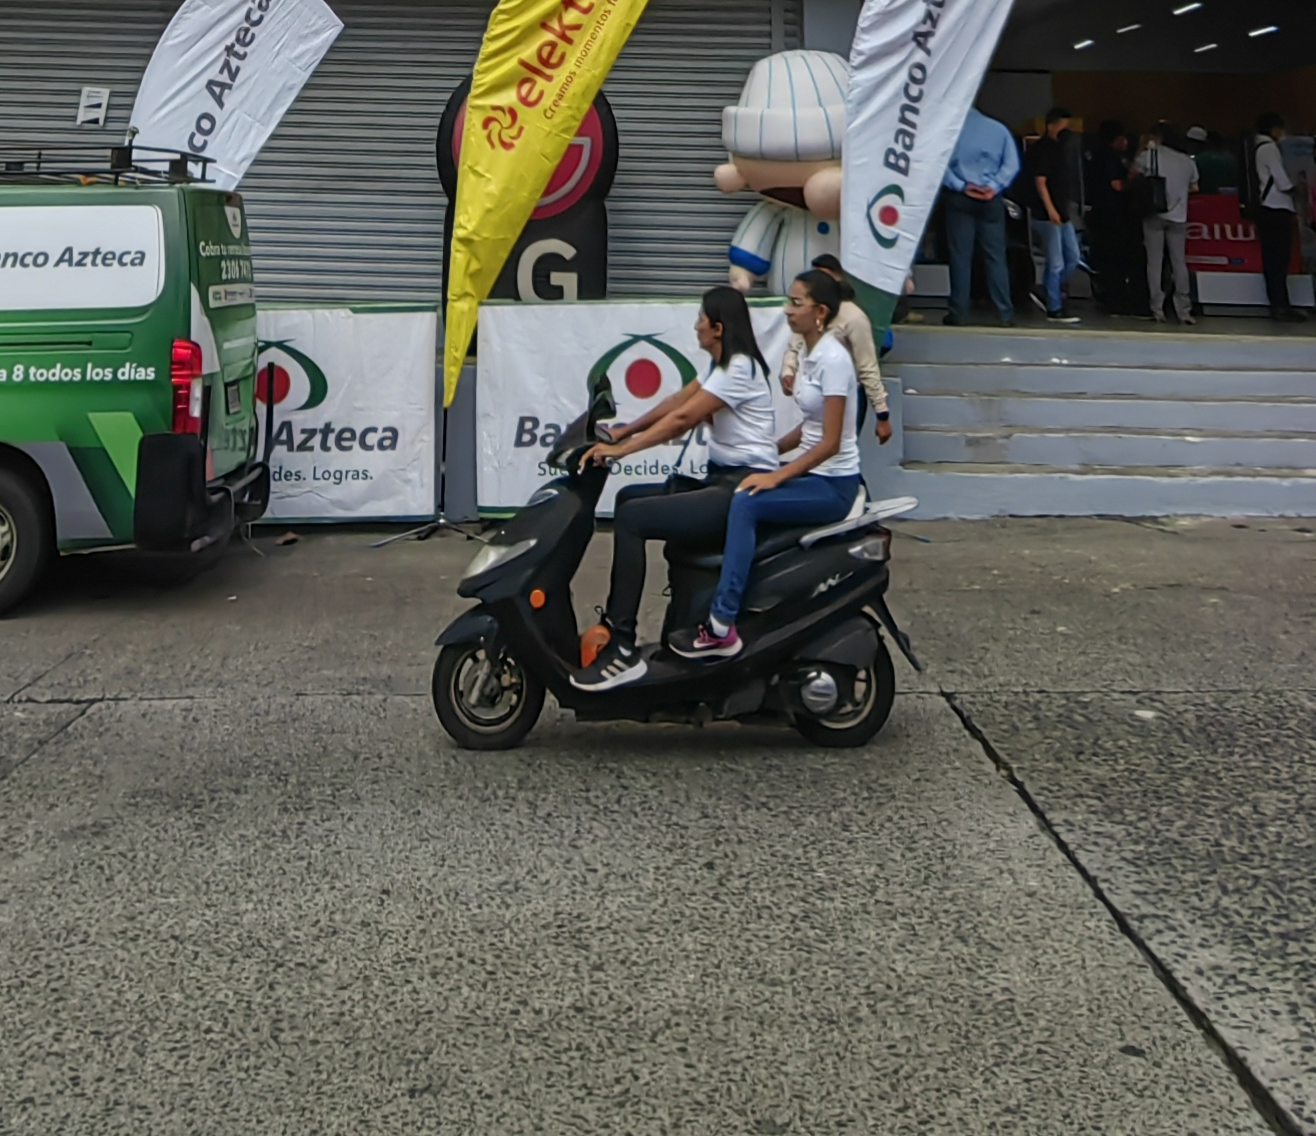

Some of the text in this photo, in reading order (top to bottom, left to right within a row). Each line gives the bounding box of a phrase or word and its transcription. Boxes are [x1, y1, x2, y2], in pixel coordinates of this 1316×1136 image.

[542, 70, 578, 121] Creamos
[575, 8, 612, 70] momentos
[883, 61, 927, 177] Banco
[1186, 222, 1257, 241] aiw
[53, 246, 146, 268] Azteca
[516, 237, 578, 301] G
[12, 364, 24, 382] 8
[29, 363, 81, 382] todos
[86, 363, 113, 381] los
[117, 362, 156, 381] días
[273, 420, 399, 452] Azteca
[312, 466, 373, 484] Logras.
